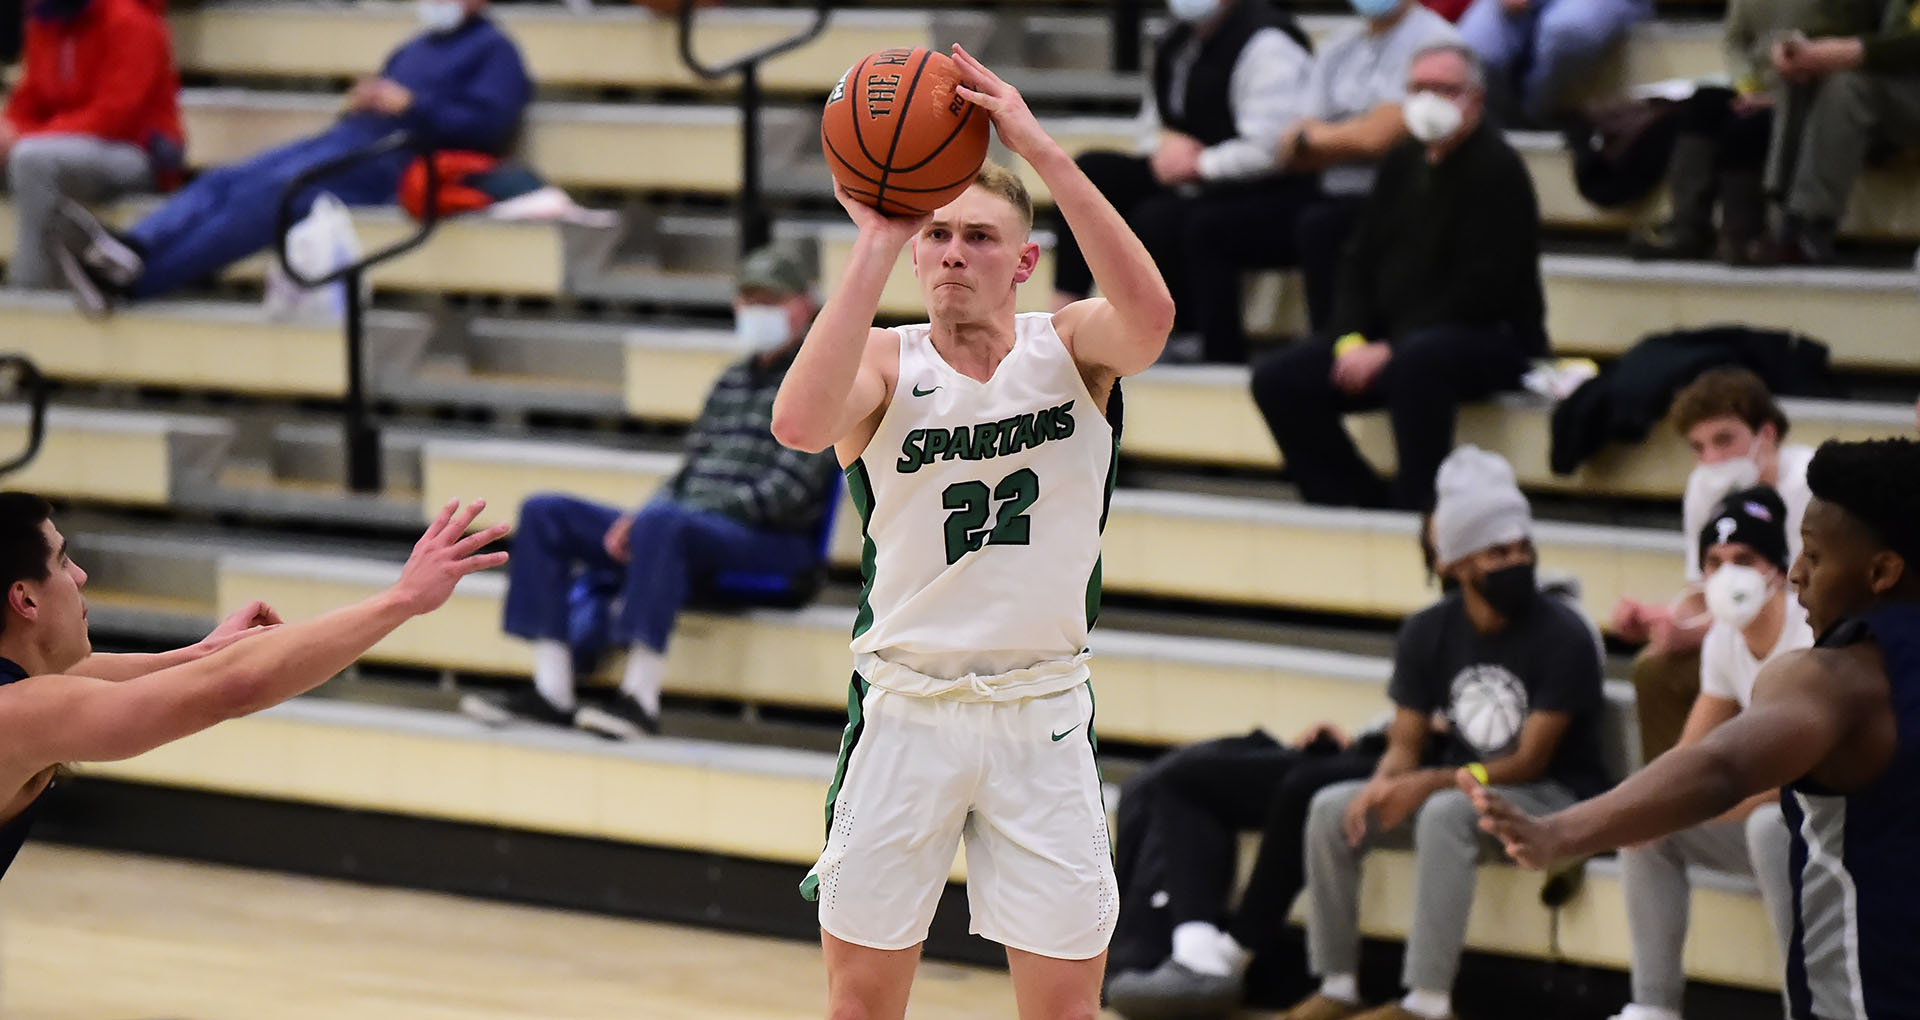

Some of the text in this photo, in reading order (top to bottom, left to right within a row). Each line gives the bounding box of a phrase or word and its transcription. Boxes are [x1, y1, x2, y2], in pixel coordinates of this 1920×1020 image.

[867, 48, 912, 120] THE RO
[896, 399, 1076, 474] SPARTANS
[942, 467, 1040, 566] 22
